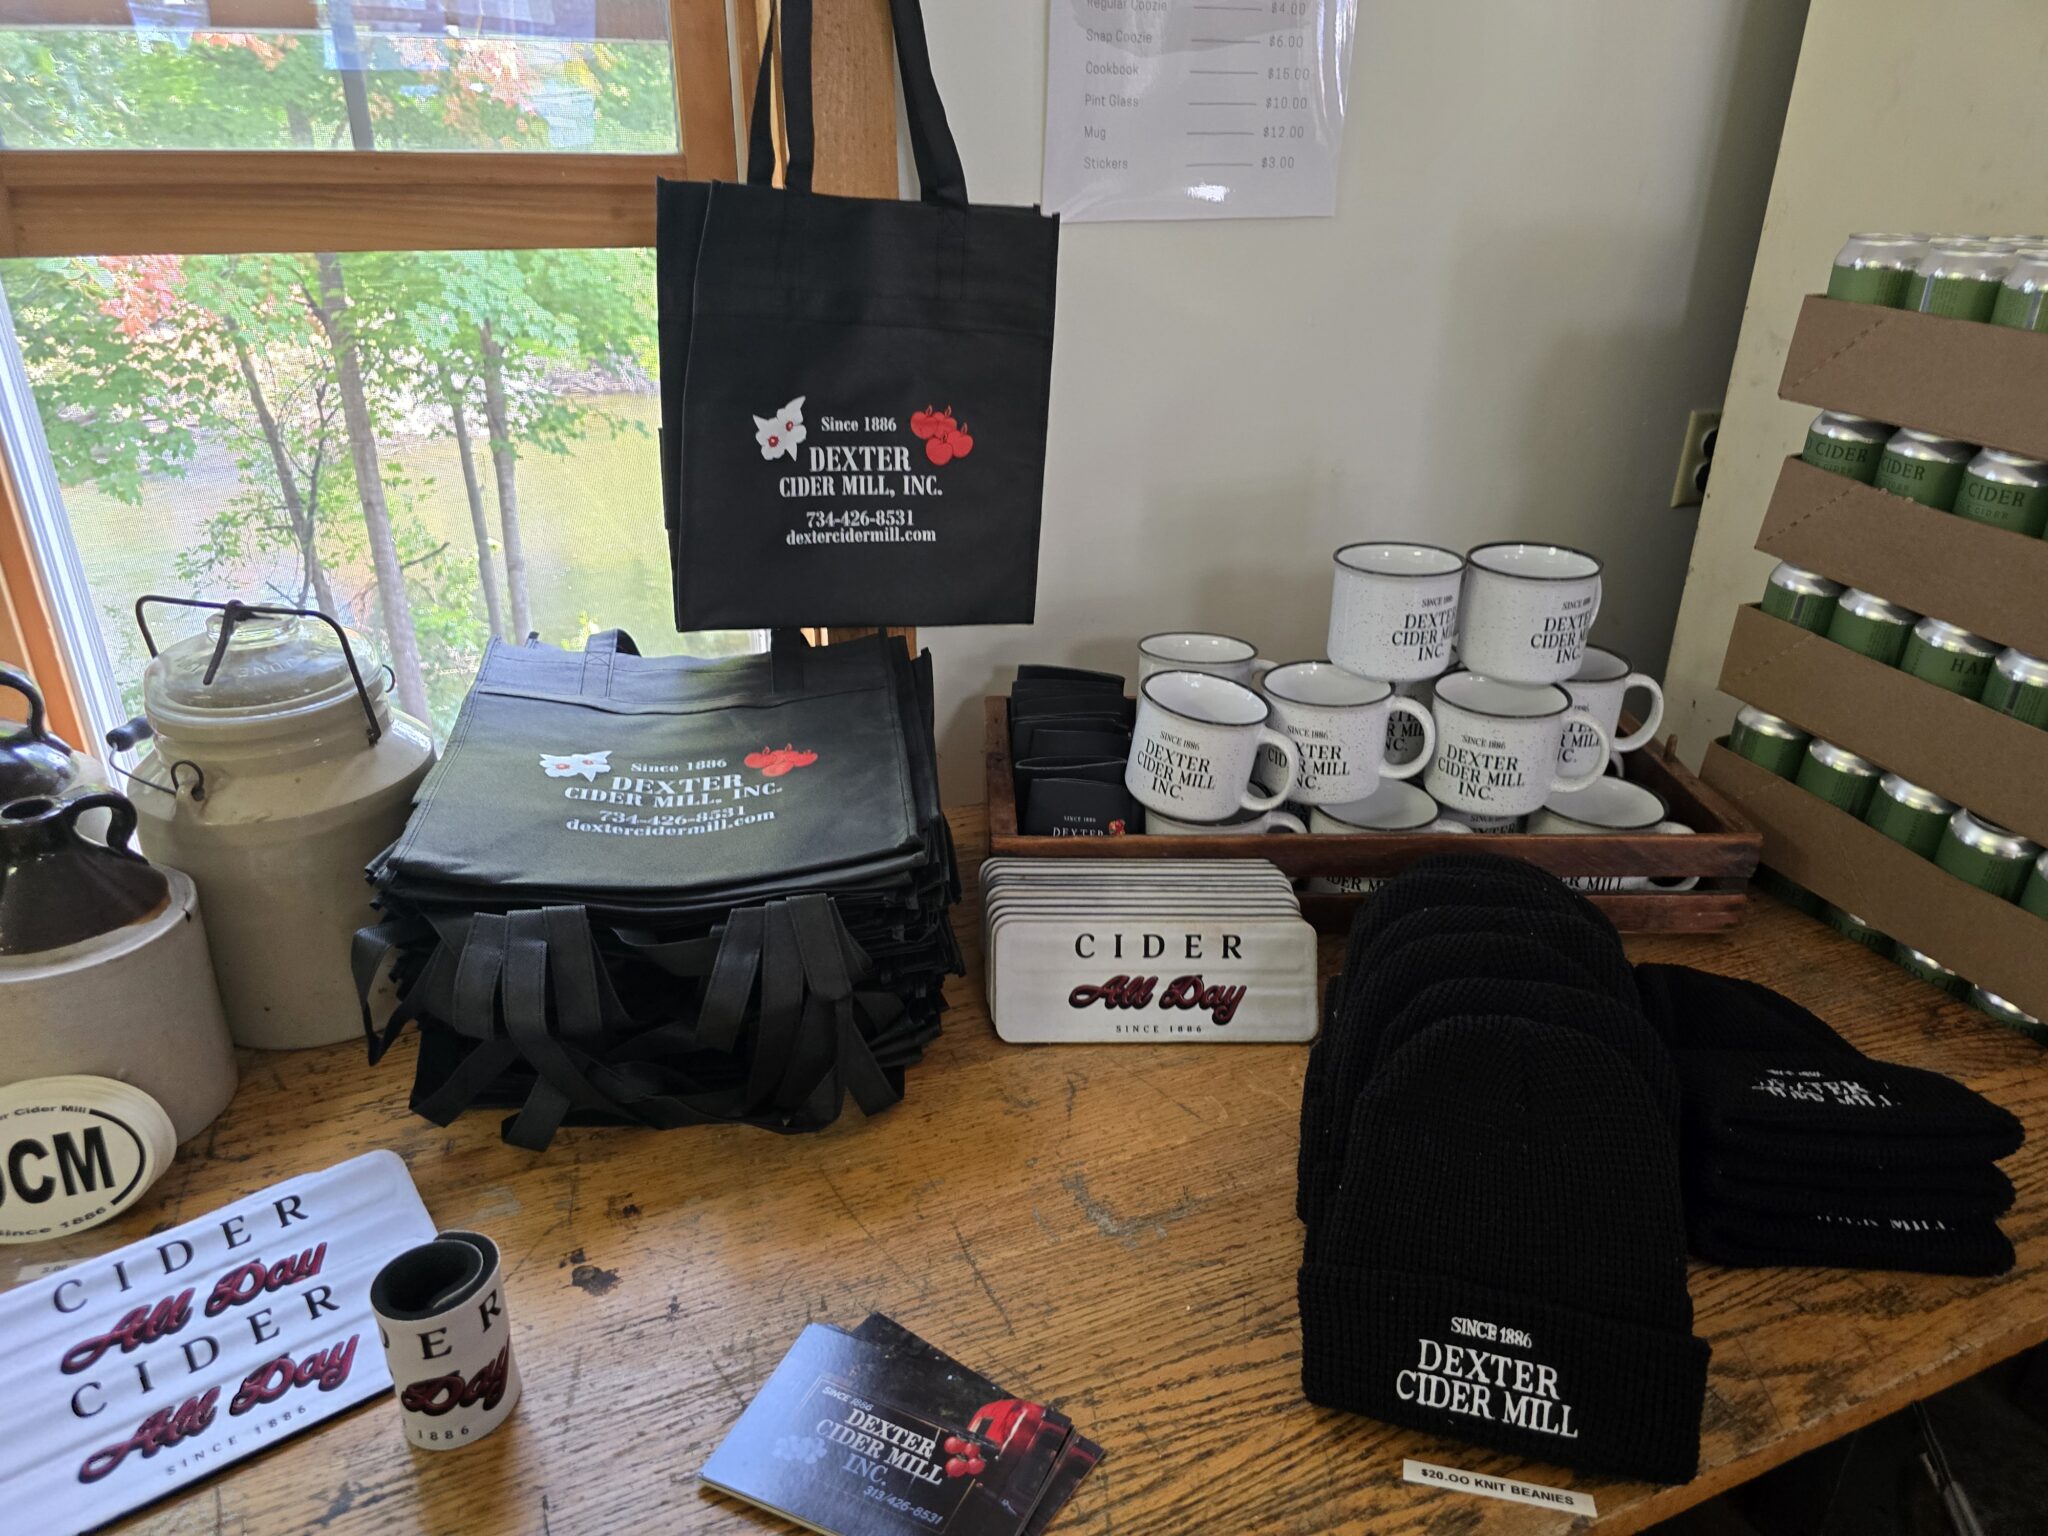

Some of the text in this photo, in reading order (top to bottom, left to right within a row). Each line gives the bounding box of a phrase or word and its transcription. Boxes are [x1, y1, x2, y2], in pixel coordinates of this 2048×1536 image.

[1086, 29, 1152, 44] Snap Coozie
[1269, 35, 1304, 48] $6.00
[1085, 61, 1139, 76] Cookbook
[1085, 94, 1139, 107] Pint Glass
[1265, 97, 1308, 110] $10.00
[1084, 126, 1106, 140] Mug
[1263, 126, 1304, 139] $12.00
[1083, 157, 1128, 170] Stickers
[1261, 156, 1295, 169] $3.00
[821, 416, 897, 432] Since 1886
[808, 446, 912, 473] DEXTER
[1815, 440, 1868, 463] CIDER
[779, 474, 943, 498] CIDER MILL, INC.
[1968, 477, 2026, 507] CIDER
[806, 509, 914, 528] 734-426-8531
[786, 526, 937, 546] dextercidermill.com
[1391, 629, 1438, 647] CIDER
[1530, 632, 1576, 649] CIDER
[1160, 730, 1182, 747] SINCE
[1287, 725, 1310, 737] SINCE
[1461, 735, 1486, 747] SINCE
[1145, 738, 1210, 774] DEXTER
[1295, 742, 1342, 760] XTER
[1447, 744, 1518, 771] DEXTER
[630, 758, 728, 773] Since 1886
[1137, 751, 1216, 790] CIDER MILL
[1313, 762, 1350, 776] MILL
[1437, 756, 1525, 787] CIDER MILL
[611, 773, 744, 795] DEXTER
[1151, 777, 1184, 800] INC.
[1458, 781, 1494, 801] INC.
[564, 782, 784, 809] CIDER MILL, INC.
[566, 809, 776, 837] dextercidermill.com
[598, 805, 746, 827] 734-426-8531
[1074, 932, 1243, 959] CIDER
[1068, 974, 1247, 1026] All Day
[1115, 1025, 1202, 1033] SINCE 1886
[14, 1105, 57, 1116] Cider
[61, 1105, 86, 1114] Mill
[59, 1206, 107, 1229] 1886
[52, 1194, 310, 1313] CIDER
[60, 1241, 328, 1375] All Day
[1451, 1316, 1533, 1349] SINCE 1886
[70, 1285, 340, 1419] CIDER
[1417, 1338, 1561, 1400] DEXTER
[822, 1385, 850, 1402] SINCE
[1396, 1369, 1579, 1438] CIDER MILL
[77, 1333, 361, 1485] All Day
[166, 1405, 307, 1476] SINCE 1886
[418, 1425, 470, 1440] 1886
[845, 1408, 937, 1461] DEXTER
[816, 1419, 944, 1487] CIDER MILL
[842, 1452, 888, 1486] INC.
[1474, 1478, 1506, 1492] KNIT
[1510, 1485, 1574, 1506] BEANIES
[863, 1484, 944, 1525] 313/426-8531
